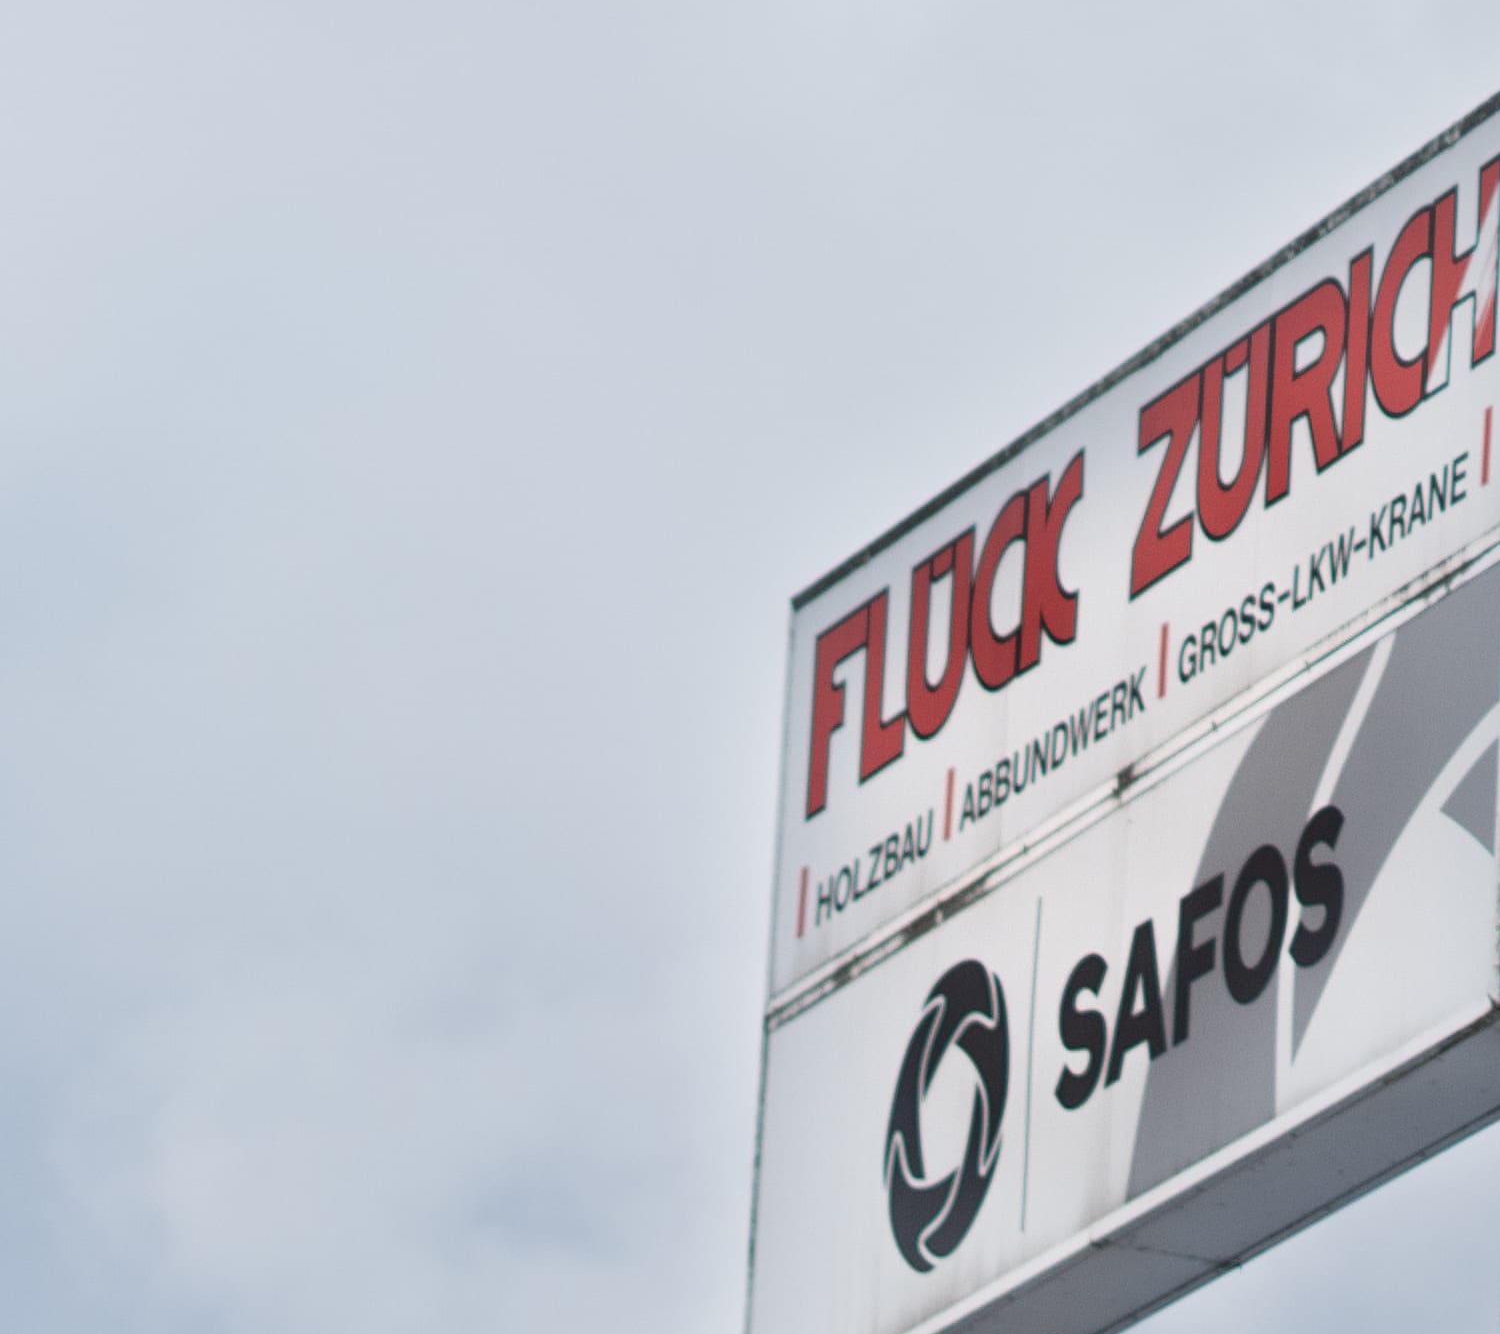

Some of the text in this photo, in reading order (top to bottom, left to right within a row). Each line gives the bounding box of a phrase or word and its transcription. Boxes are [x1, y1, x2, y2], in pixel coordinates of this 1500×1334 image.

[806, 447, 1085, 822] FLÜCK
[815, 452, 1469, 926] HOLZBAU ABBUNDWERK GROSS-LKW-KRANE
[1053, 805, 1345, 1111] SAFOS
